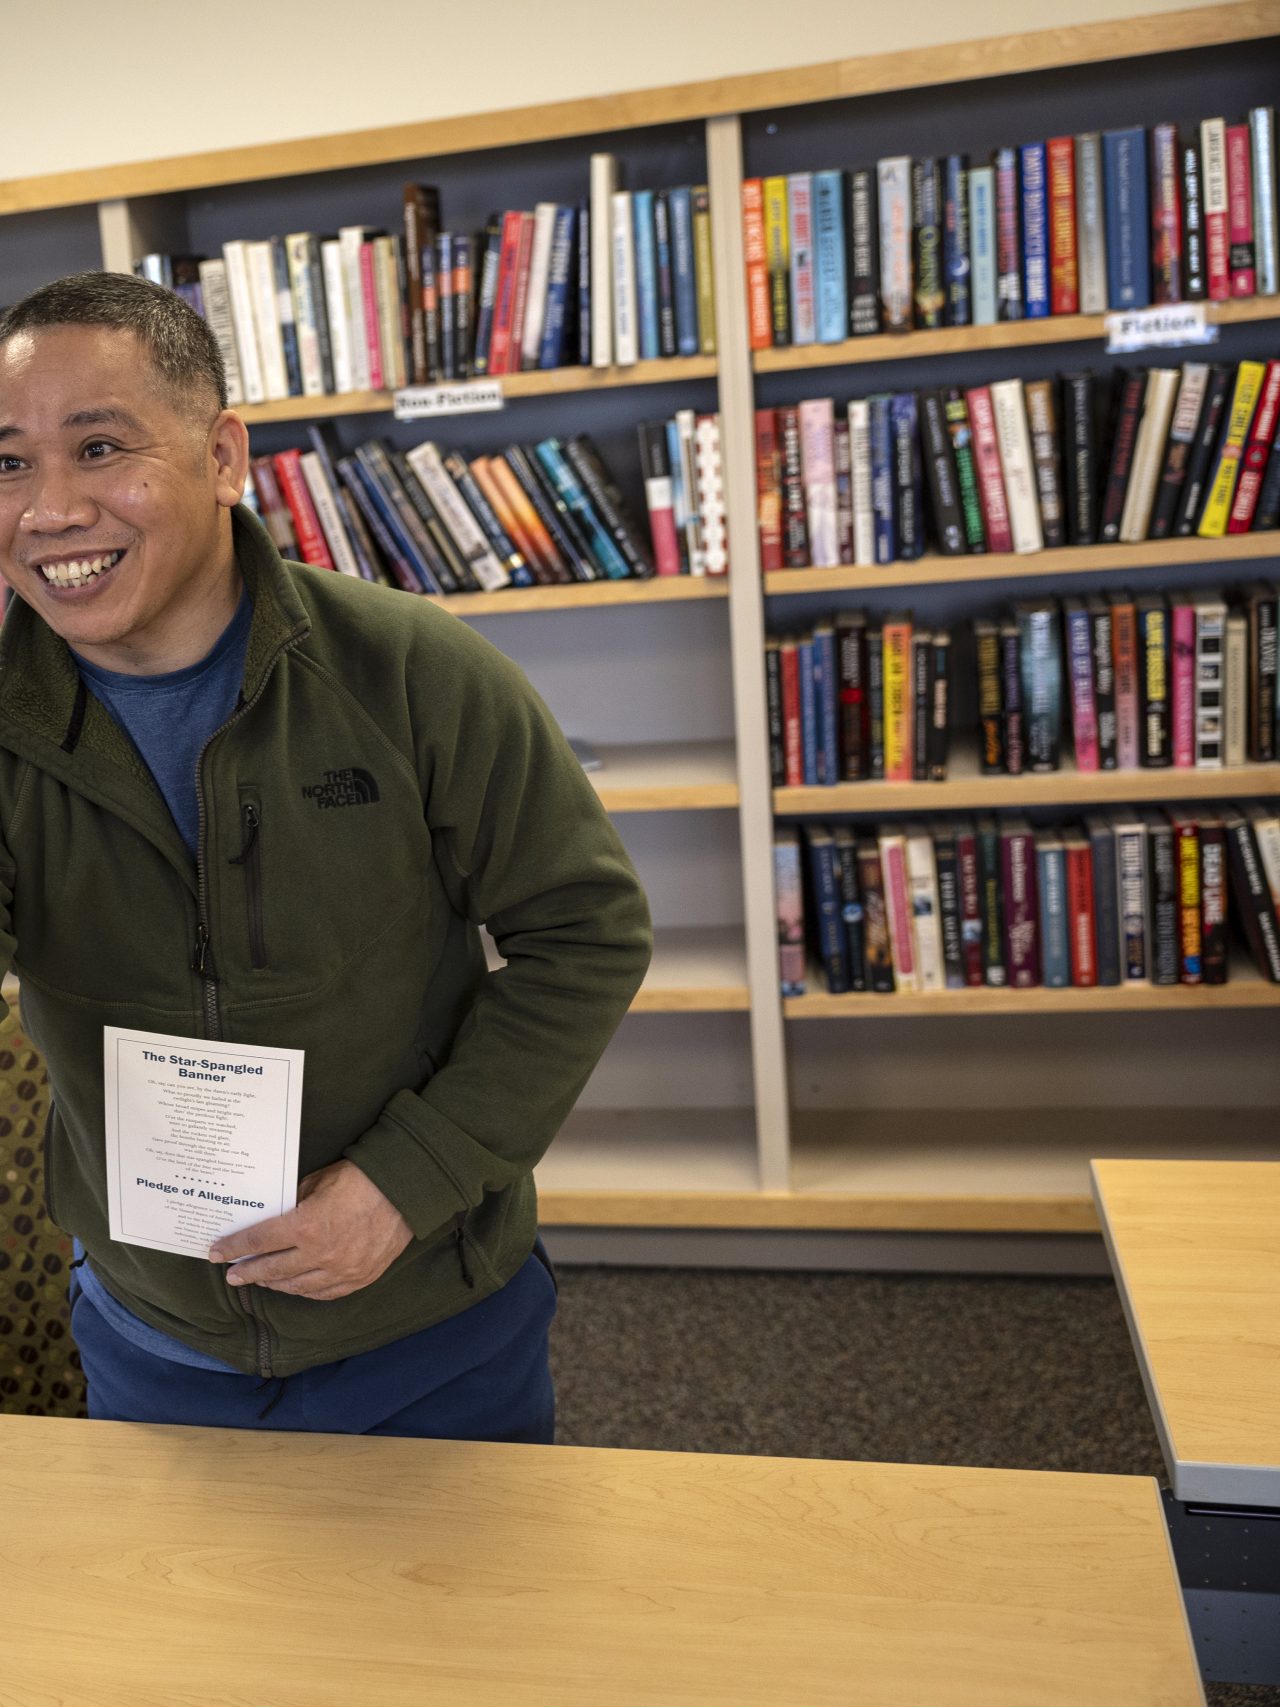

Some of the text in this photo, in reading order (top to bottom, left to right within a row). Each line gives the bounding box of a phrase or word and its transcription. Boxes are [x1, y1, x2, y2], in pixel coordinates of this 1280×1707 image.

[1121, 315, 1197, 336] Fiction
[396, 392, 497, 408] Non-Fiction
[323, 768, 353, 783] THE
[302, 780, 353, 799] NORTH
[317, 794, 355, 810] FACE
[142, 1051, 263, 1075] The Star-Spangled
[178, 1068, 226, 1083] Banner
[136, 1177, 265, 1209] Pledge of Allegiance
